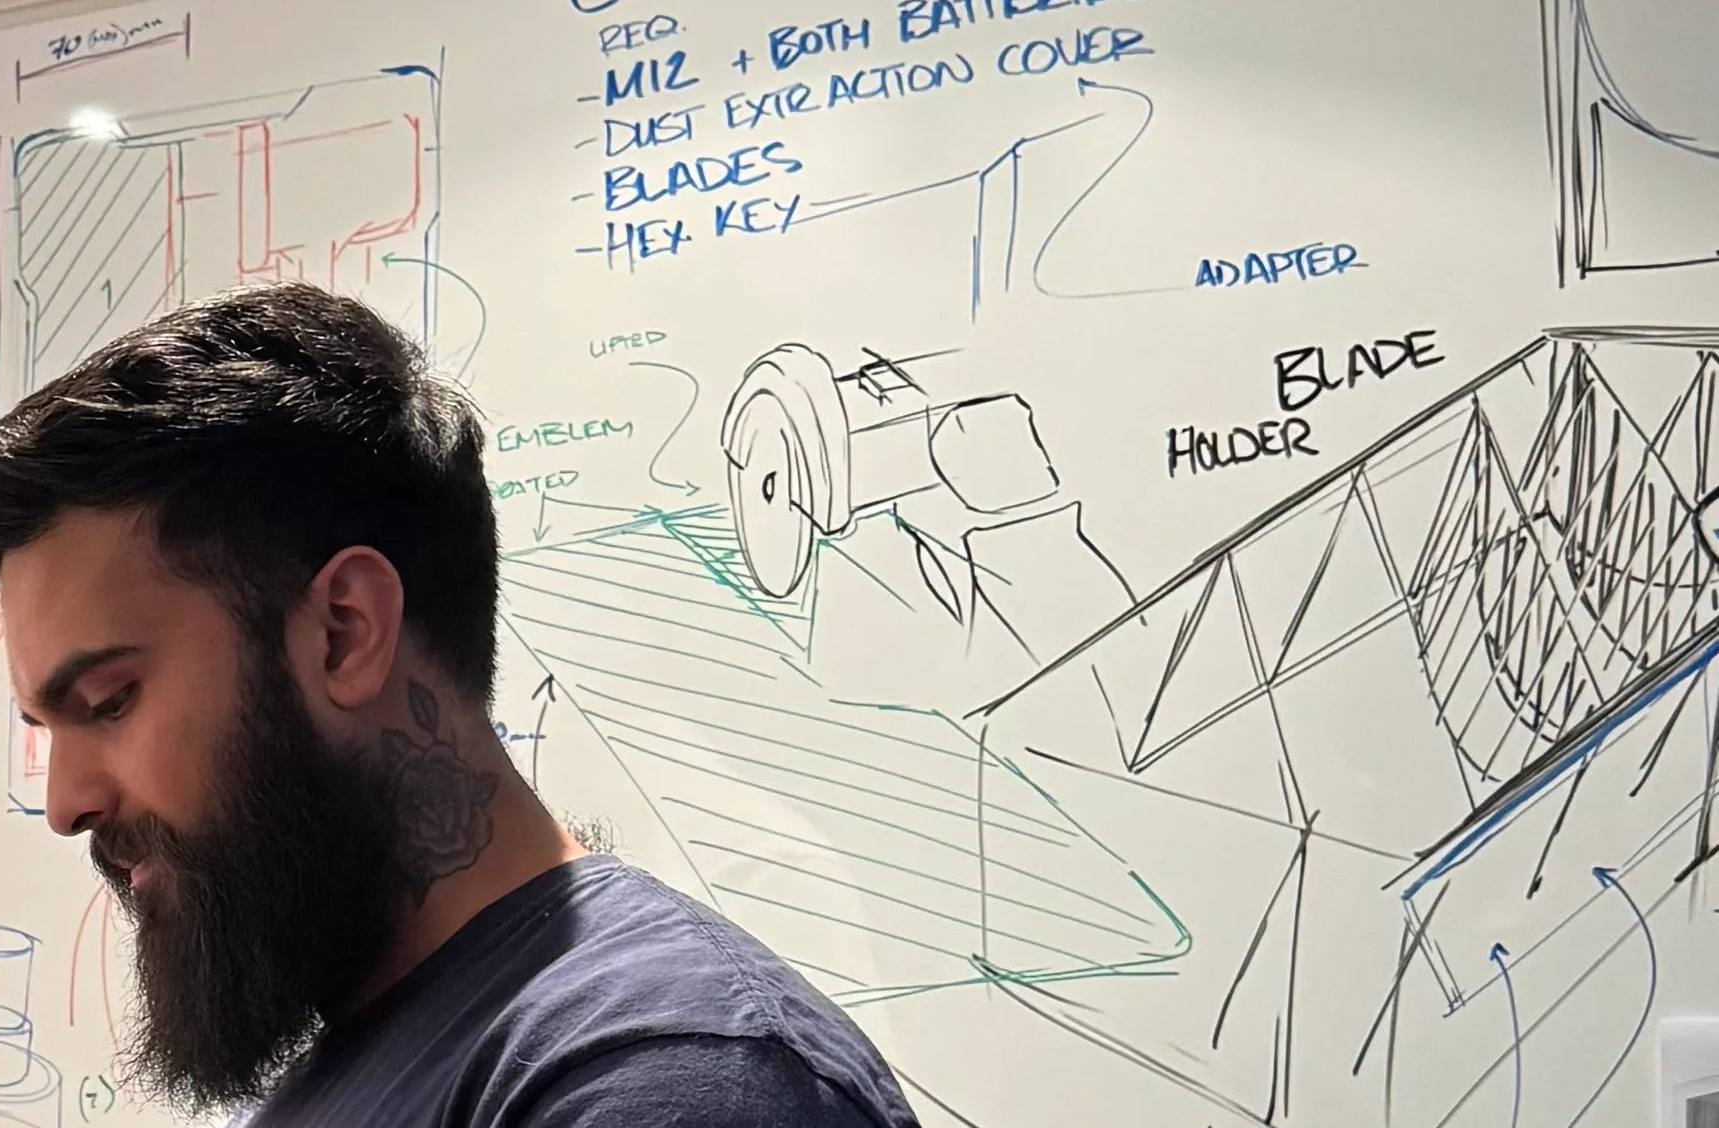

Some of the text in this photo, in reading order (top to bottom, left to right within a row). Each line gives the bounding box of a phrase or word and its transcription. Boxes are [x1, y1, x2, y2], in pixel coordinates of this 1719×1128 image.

[768, 18, 870, 70] BOTH
[724, 53, 974, 129] EXTRACTION
[997, 26, 1156, 76] COVER
[715, 194, 801, 236] KEY
[1195, 242, 1369, 287] ADAPTER
[1274, 330, 1446, 412] BLADE
[1167, 417, 1320, 478] HOLDER
